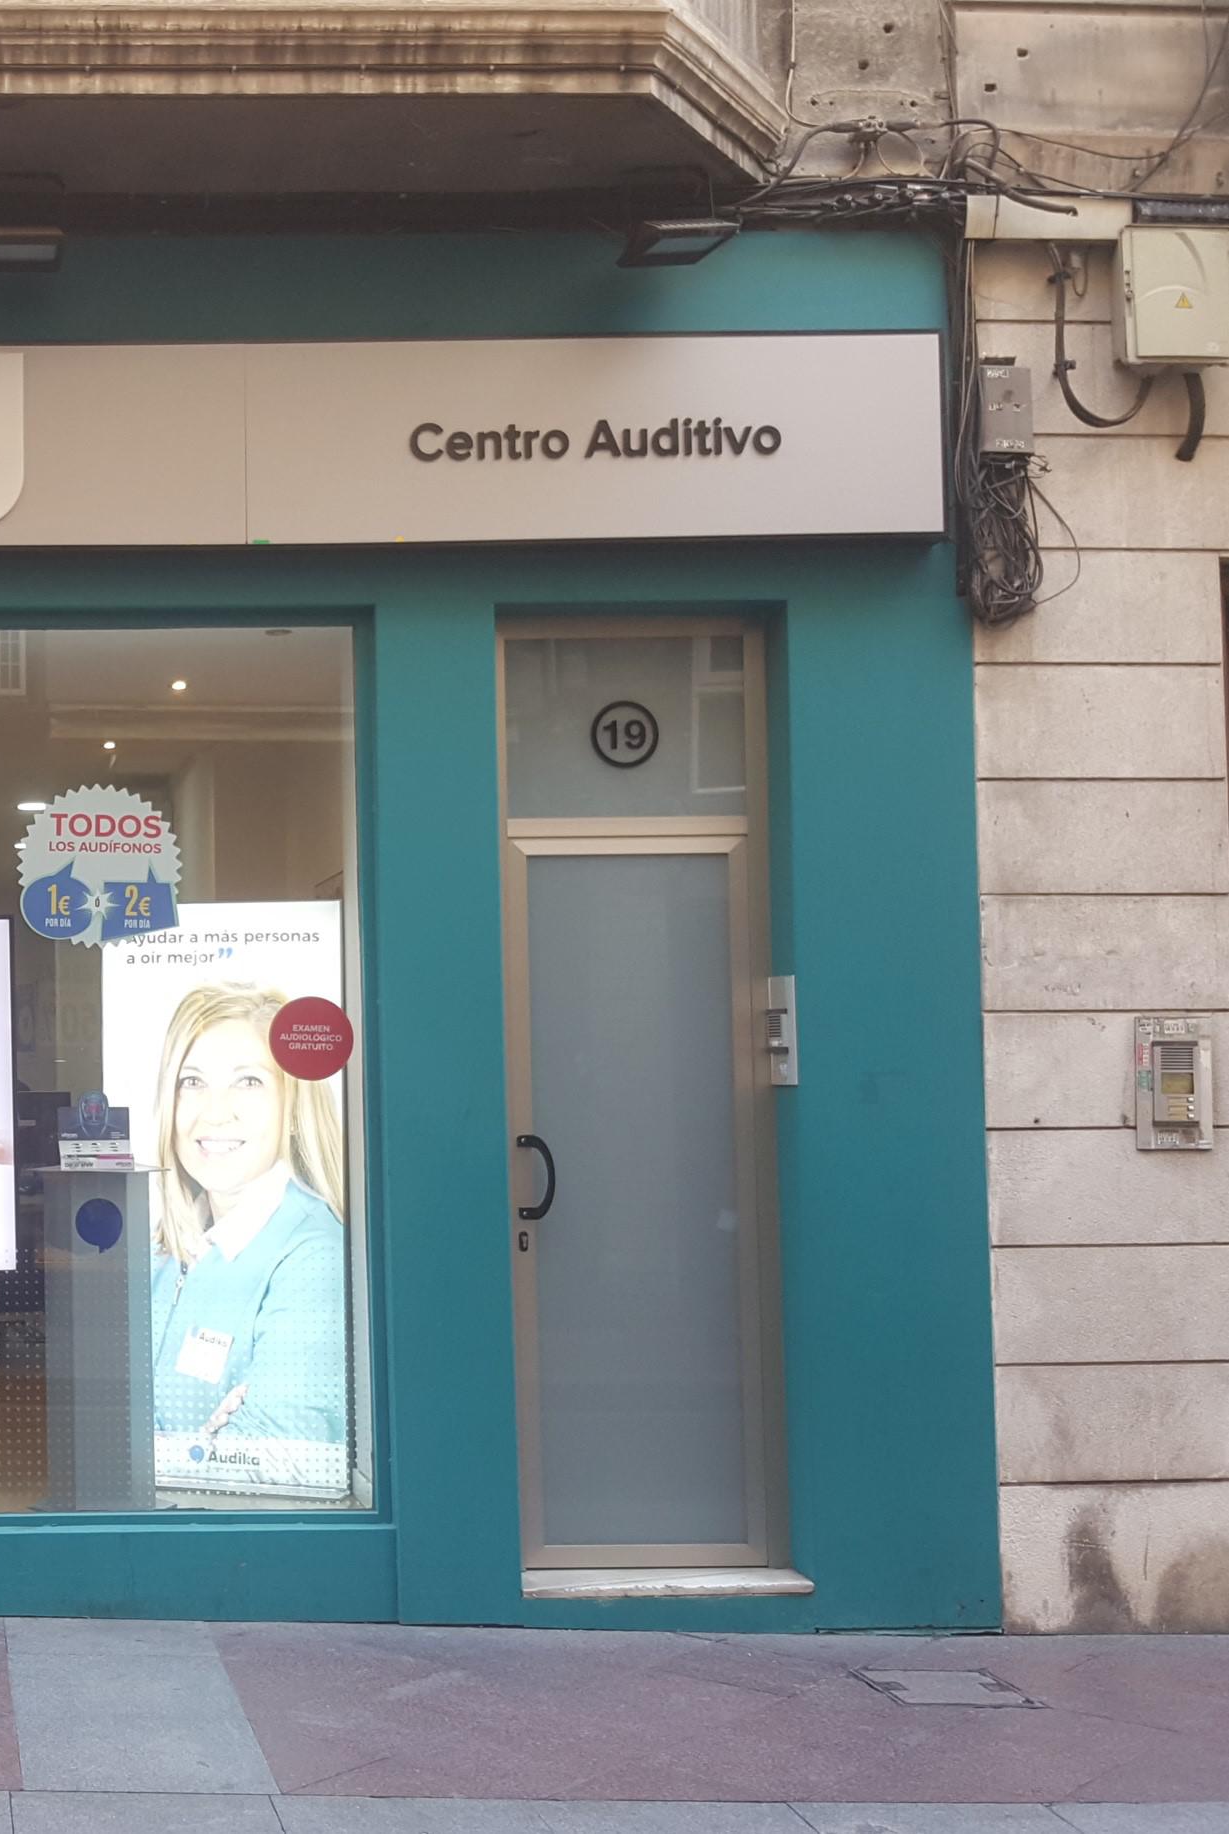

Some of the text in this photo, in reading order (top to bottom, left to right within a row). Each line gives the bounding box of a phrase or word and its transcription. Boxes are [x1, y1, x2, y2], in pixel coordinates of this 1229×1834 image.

[409, 417, 782, 462] Centro Auditivo
[602, 719, 647, 750] 19
[50, 813, 162, 839] TODOS
[49, 839, 162, 854] LOS AUDÍFONOS
[47, 884, 71, 916] 1€
[125, 885, 151, 917] 2€
[45, 918, 58, 927] POR
[124, 919, 137, 929] POR
[189, 933, 198, 943] a
[244, 930, 320, 945] personas
[126, 954, 135, 964] a
[292, 1024, 330, 1033] EXAMEN
[279, 1032, 342, 1042] AUDIOLÓGICO
[288, 1042, 334, 1051] GRATUITO
[208, 1450, 260, 1466] Audika
